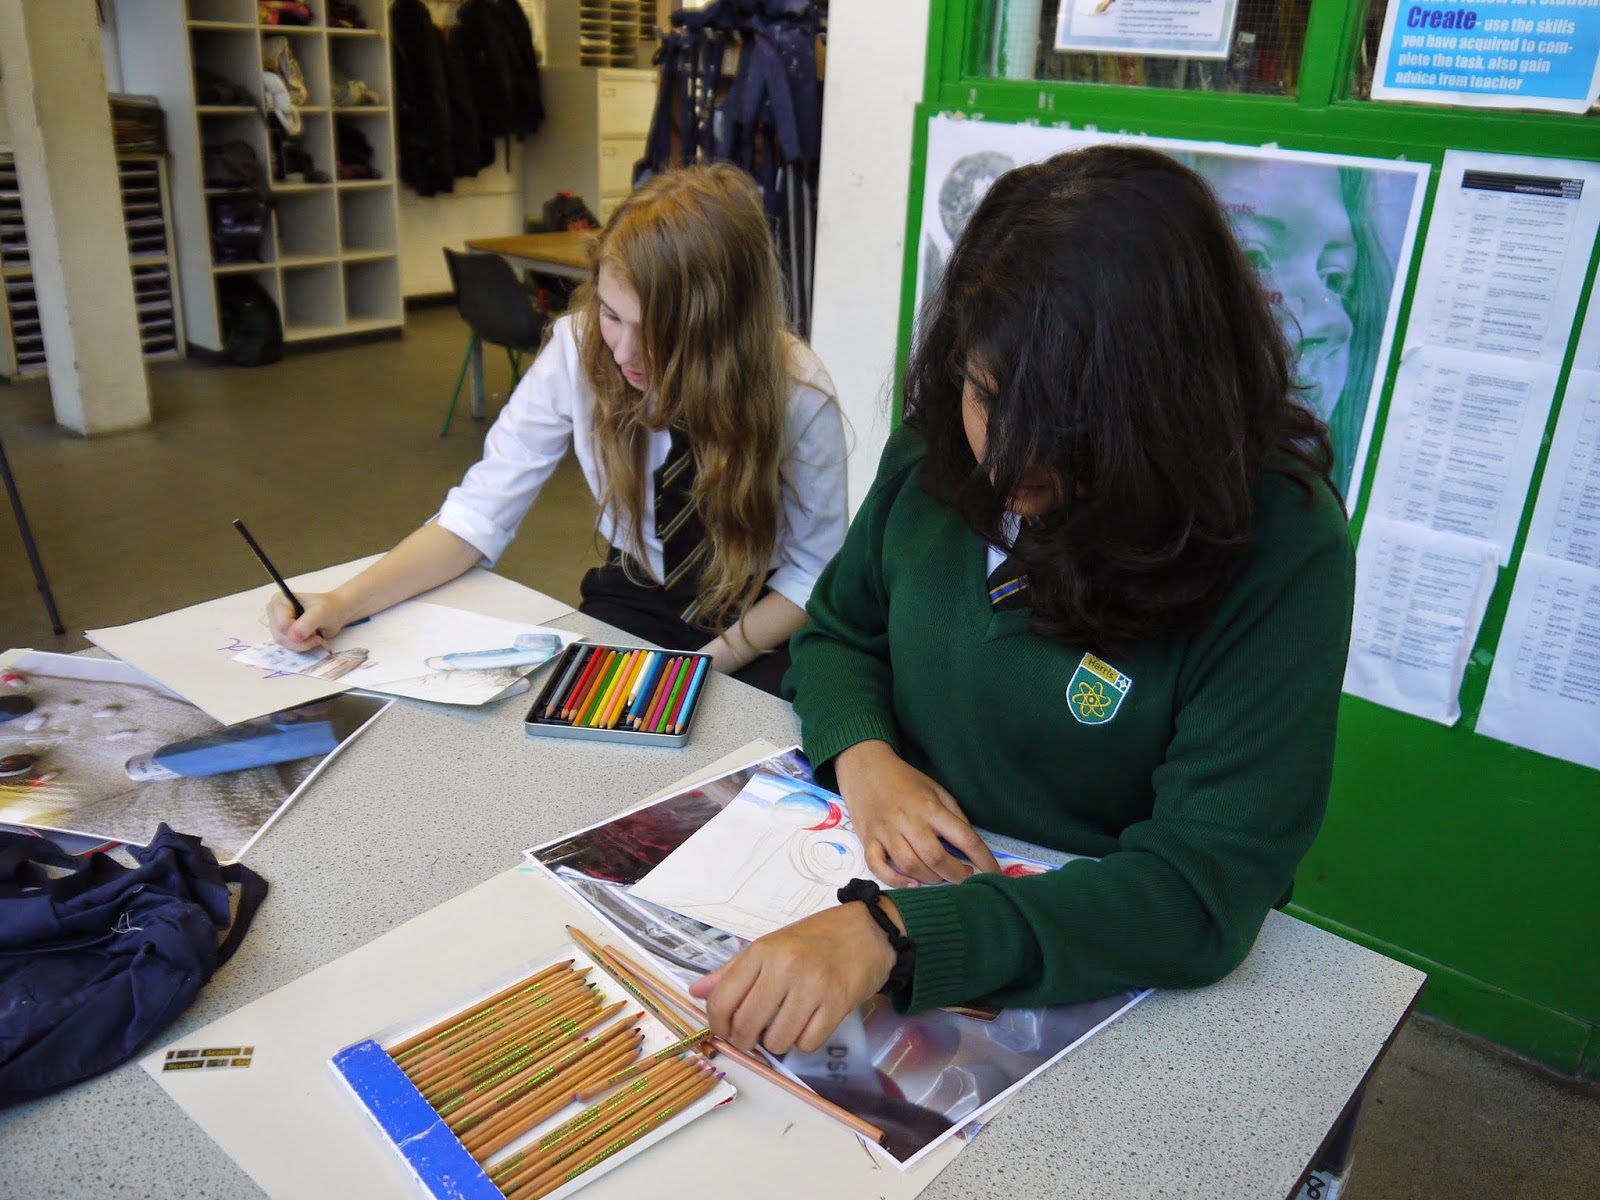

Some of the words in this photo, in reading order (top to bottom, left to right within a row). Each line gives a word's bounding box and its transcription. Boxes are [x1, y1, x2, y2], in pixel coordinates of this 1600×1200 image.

[1484, 19, 1509, 32] use
[1511, 18, 1534, 33] the
[1536, 18, 1575, 34] skills
[1401, 34, 1425, 48] you
[1426, 33, 1457, 49] have
[1459, 36, 1520, 52] acquired
[1521, 39, 1536, 52] to
[1398, 51, 1430, 66] plete
[1432, 53, 1453, 67] the
[1487, 56, 1518, 71] also
[1519, 58, 1551, 73] gain
[1395, 70, 1436, 85] advice
[1438, 71, 1468, 87] from
[1470, 74, 1524, 90] teacher
[1088, 658, 1114, 678] Harris
